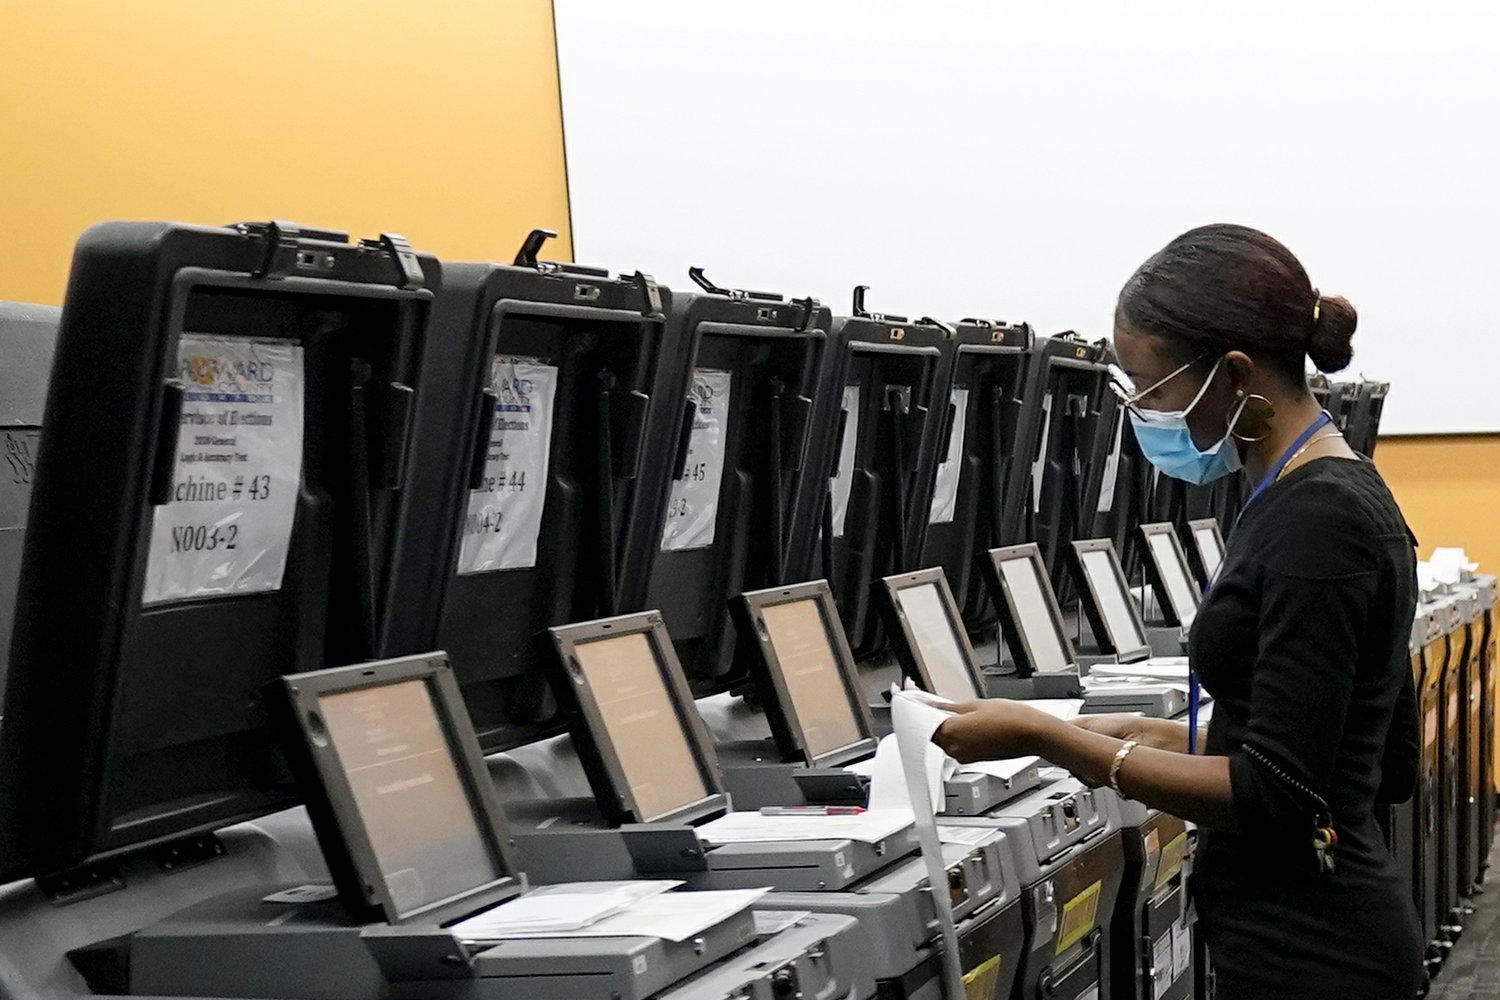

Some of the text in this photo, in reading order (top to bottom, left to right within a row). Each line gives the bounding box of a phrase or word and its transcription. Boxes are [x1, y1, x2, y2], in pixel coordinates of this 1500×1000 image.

[509, 471, 526, 492] 44
[693, 463, 706, 482] 45
[175, 475, 228, 502] chine
[248, 474, 271, 501] 43
[171, 524, 239, 553] N003-2
